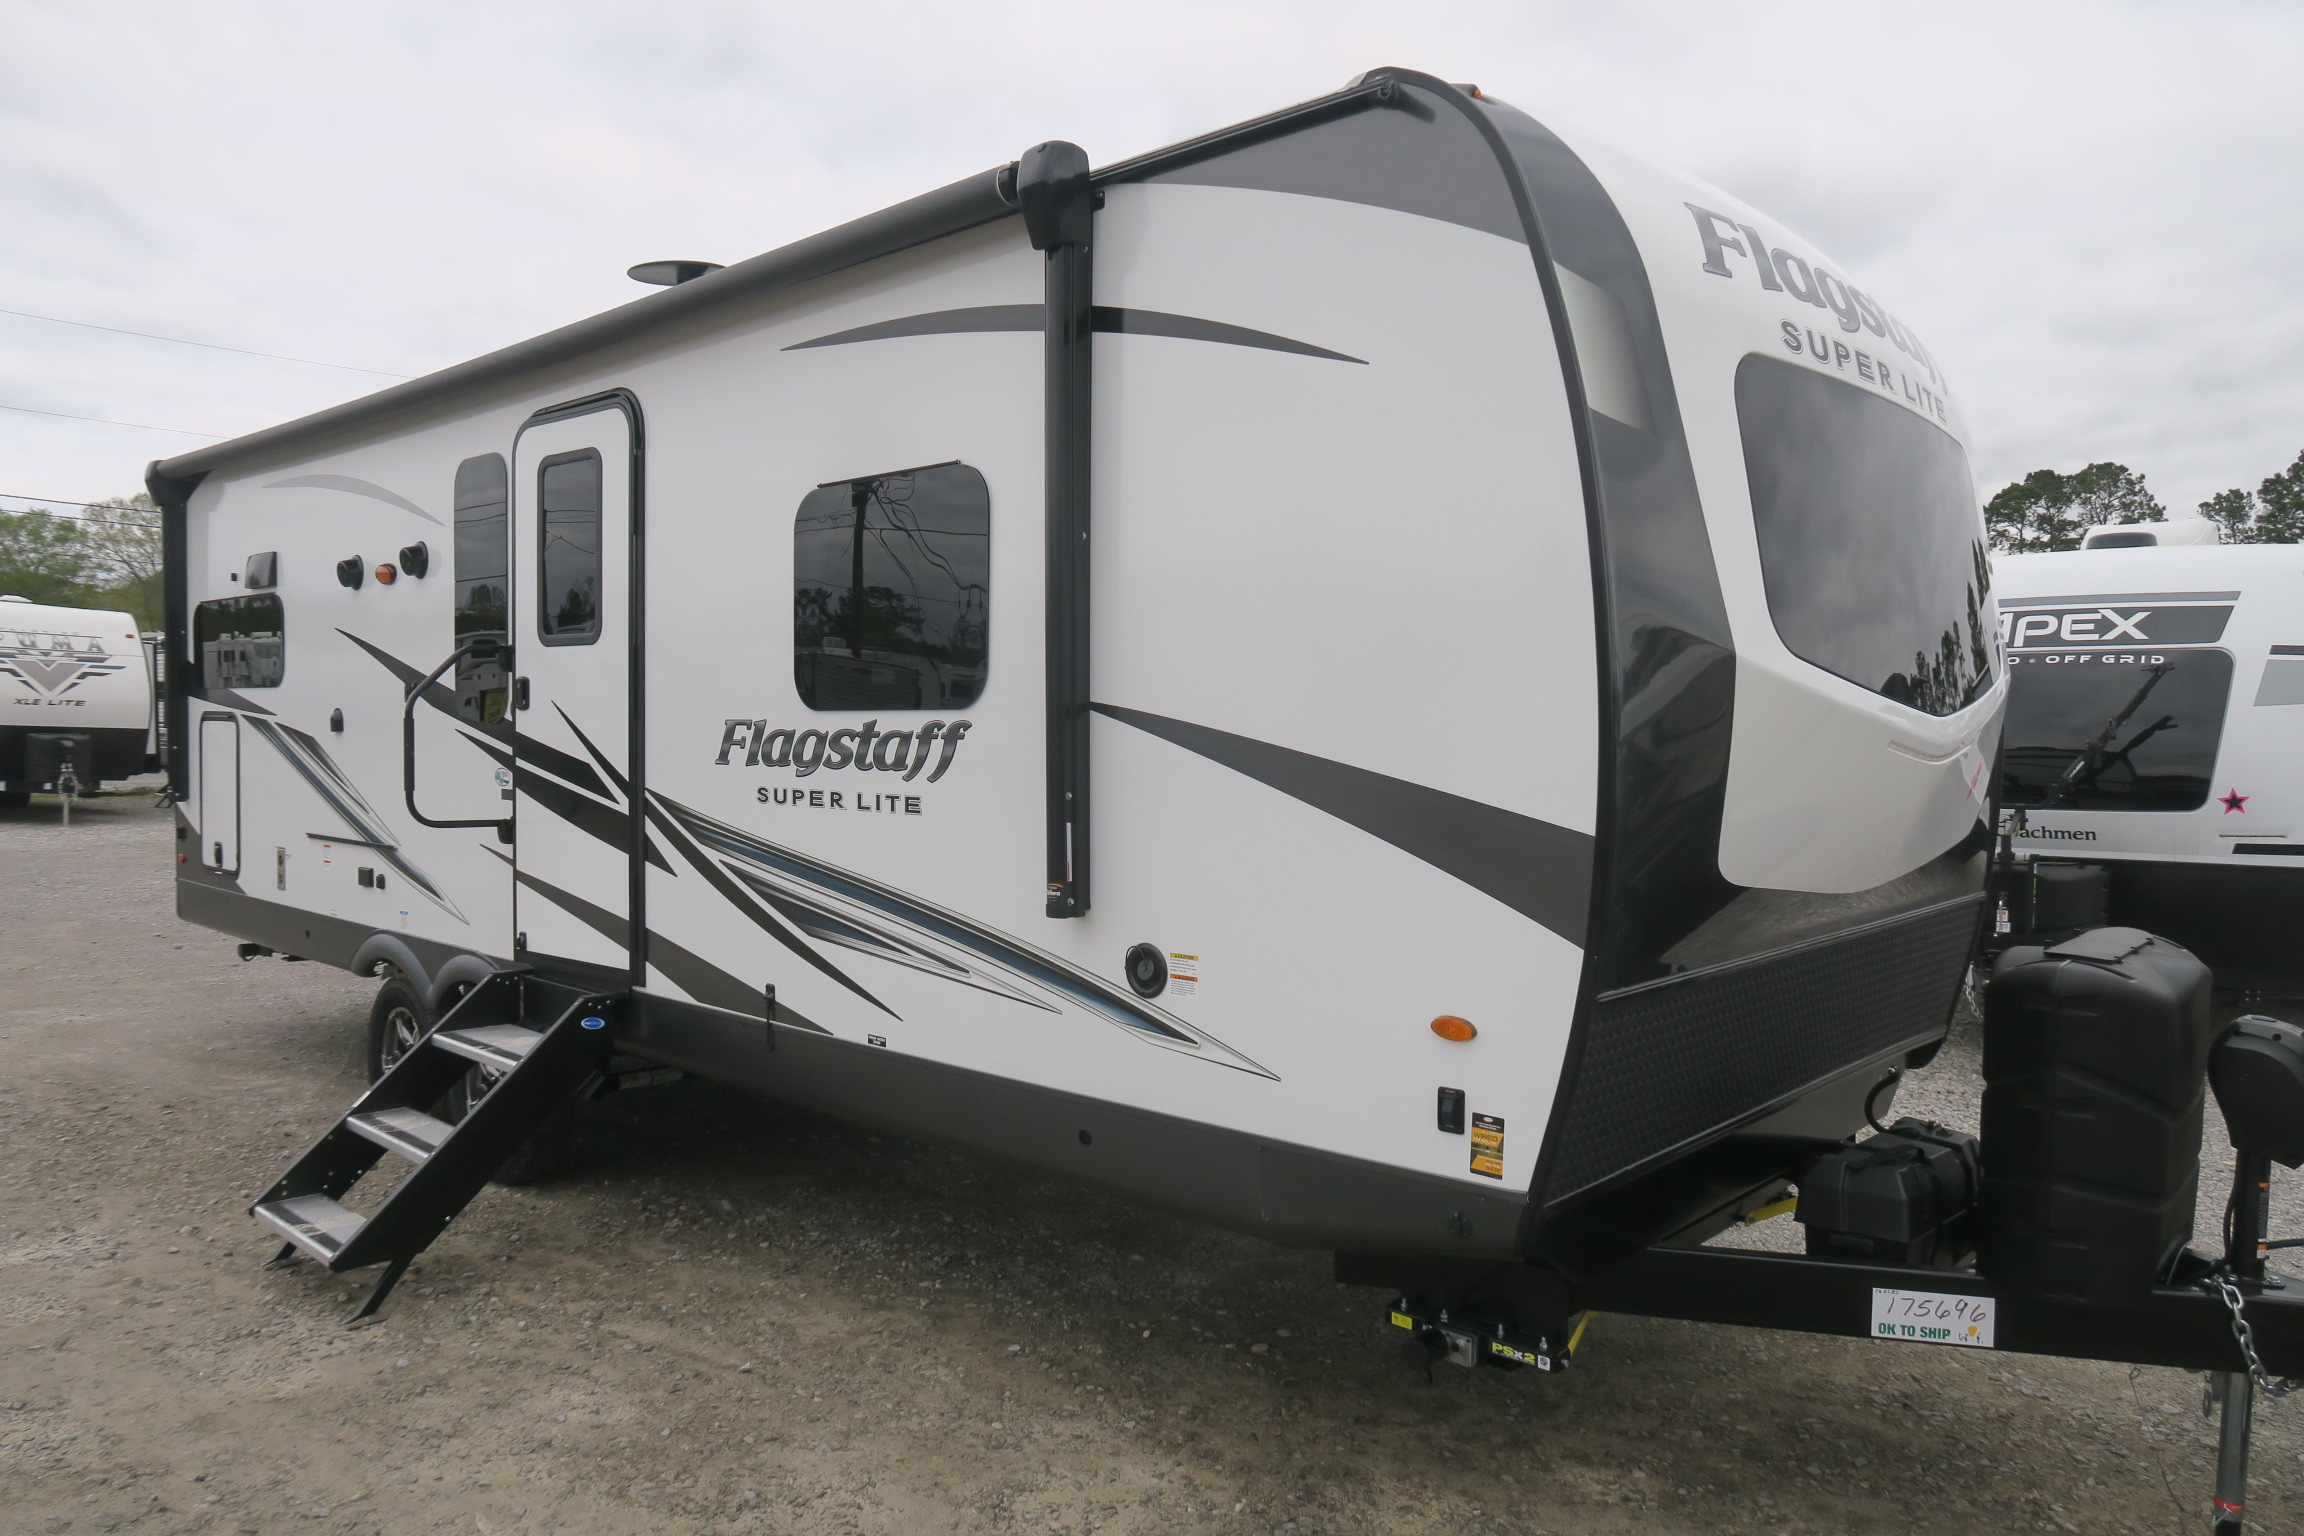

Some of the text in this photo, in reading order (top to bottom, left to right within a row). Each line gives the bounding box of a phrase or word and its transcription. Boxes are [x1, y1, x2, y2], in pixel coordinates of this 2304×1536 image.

[1780, 318, 1948, 425] SUPER LITE
[0, 633, 104, 653] UMA
[2045, 654, 2165, 664] OFF GRID
[13, 698, 86, 707] XLE LITE
[715, 718, 973, 783] Flagstaff
[756, 786, 923, 816] SUPER LITE
[1998, 825, 2097, 841] achmen
[1473, 1132, 1498, 1143] WIRED
[1887, 1297, 1987, 1322] 175696
[1878, 1322, 1951, 1340] OK TO SHIP
[1492, 1342, 1535, 1363] PSx2
